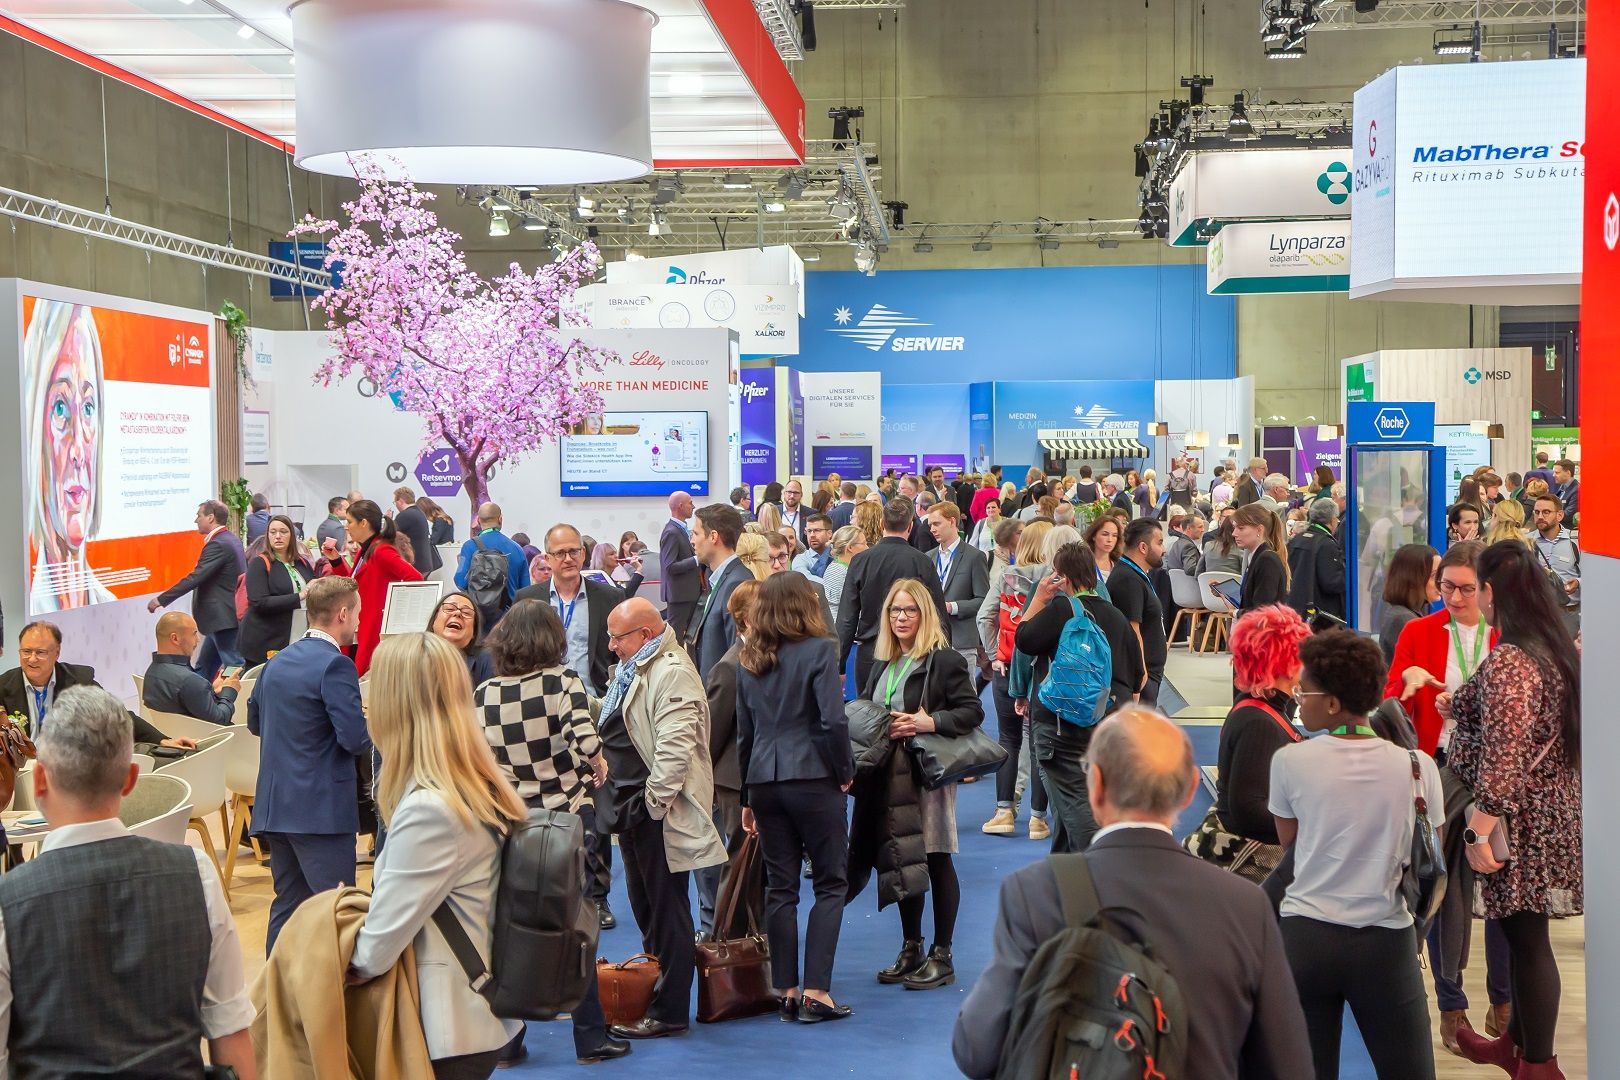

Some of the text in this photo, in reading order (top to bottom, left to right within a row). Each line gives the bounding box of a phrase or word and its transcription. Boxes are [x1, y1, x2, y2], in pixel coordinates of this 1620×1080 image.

[1412, 144, 1549, 162] MabThera
[1412, 167, 1586, 183] Rituximab Subkuta
[1269, 254, 1300, 264] olaparib
[608, 298, 646, 306] IBRANCE
[754, 304, 786, 312] VIZIMPRO
[891, 336, 965, 352] SERVIER
[629, 350, 666, 371] Lilly
[1485, 370, 1512, 380] MSD
[580, 380, 709, 391] MORE THAN MEDICINE
[743, 381, 769, 404] Pfizer
[1017, 420, 1057, 430] & MEHR
[1102, 421, 1140, 429] SERVIER
[1381, 415, 1404, 429] Roche
[881, 423, 917, 432] OLOGIE
[745, 449, 770, 457] HERZLICH
[1315, 453, 1342, 461] Zielgena
[421, 473, 462, 482] Retsevmo
